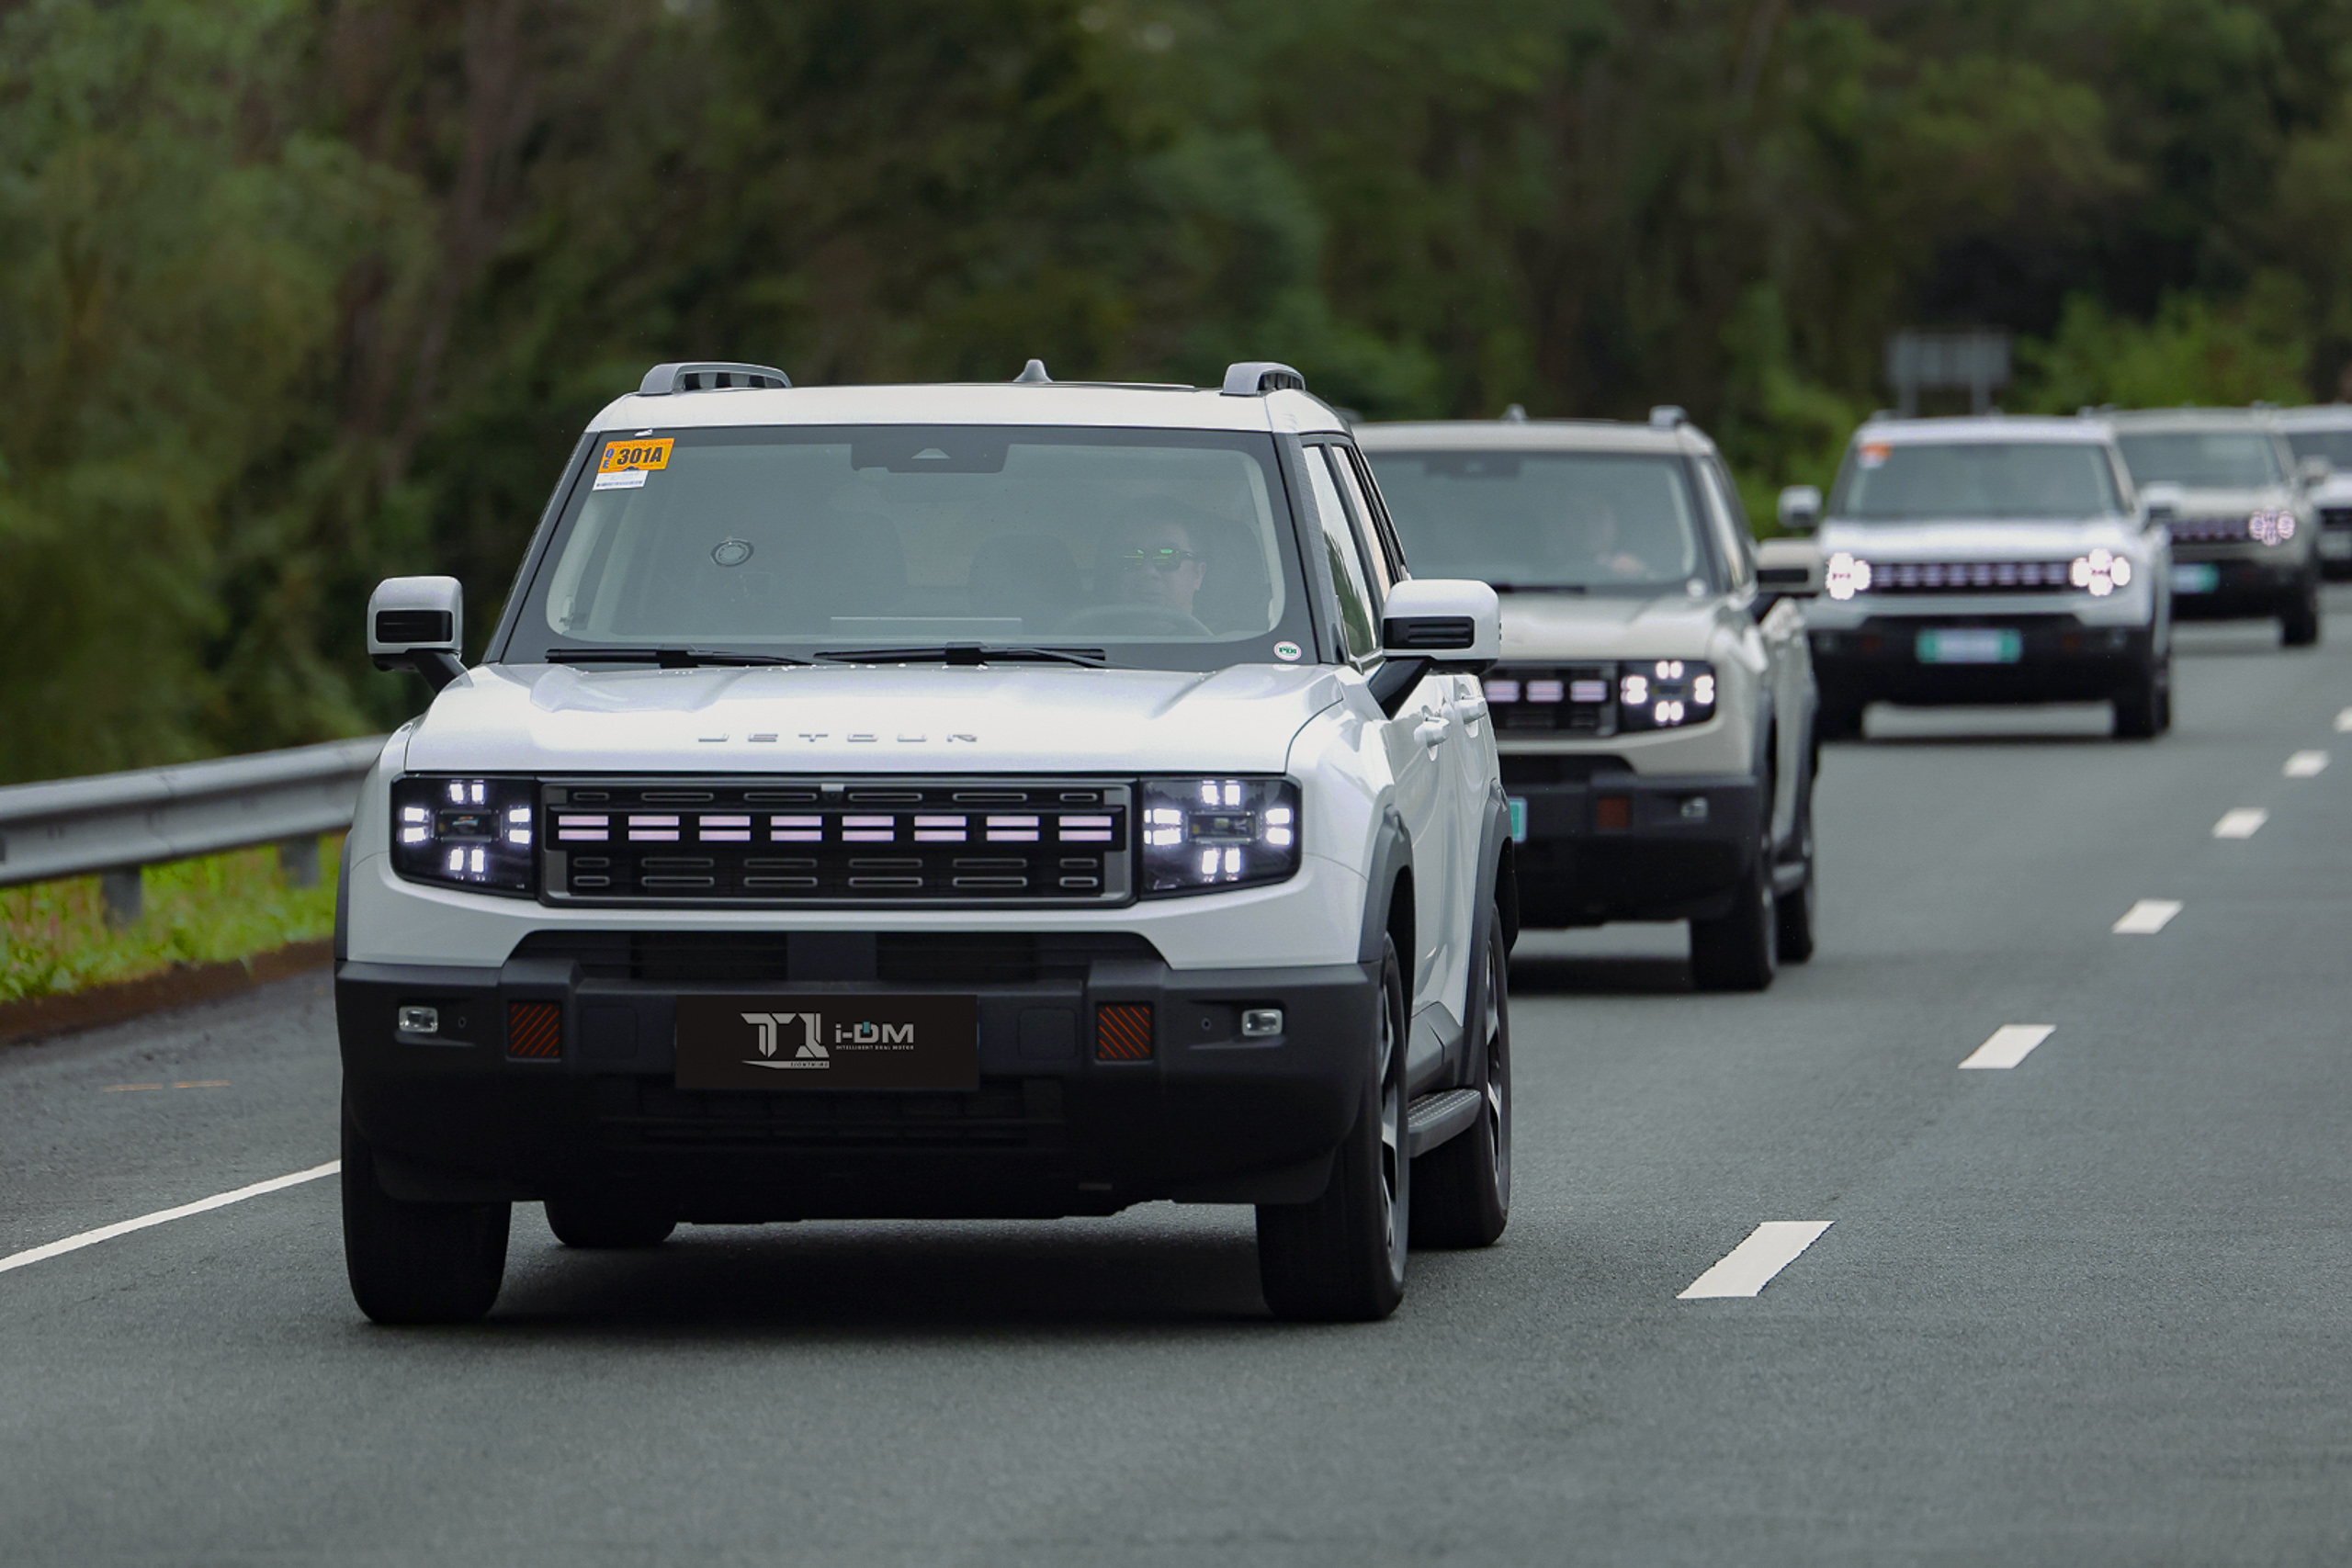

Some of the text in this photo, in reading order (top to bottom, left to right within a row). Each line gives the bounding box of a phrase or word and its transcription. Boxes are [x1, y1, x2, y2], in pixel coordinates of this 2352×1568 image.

[616, 446, 663, 466] 301A
[698, 733, 978, 742] JETOUR
[741, 1012, 830, 1058] T1
[835, 1021, 914, 1043] i-DM
